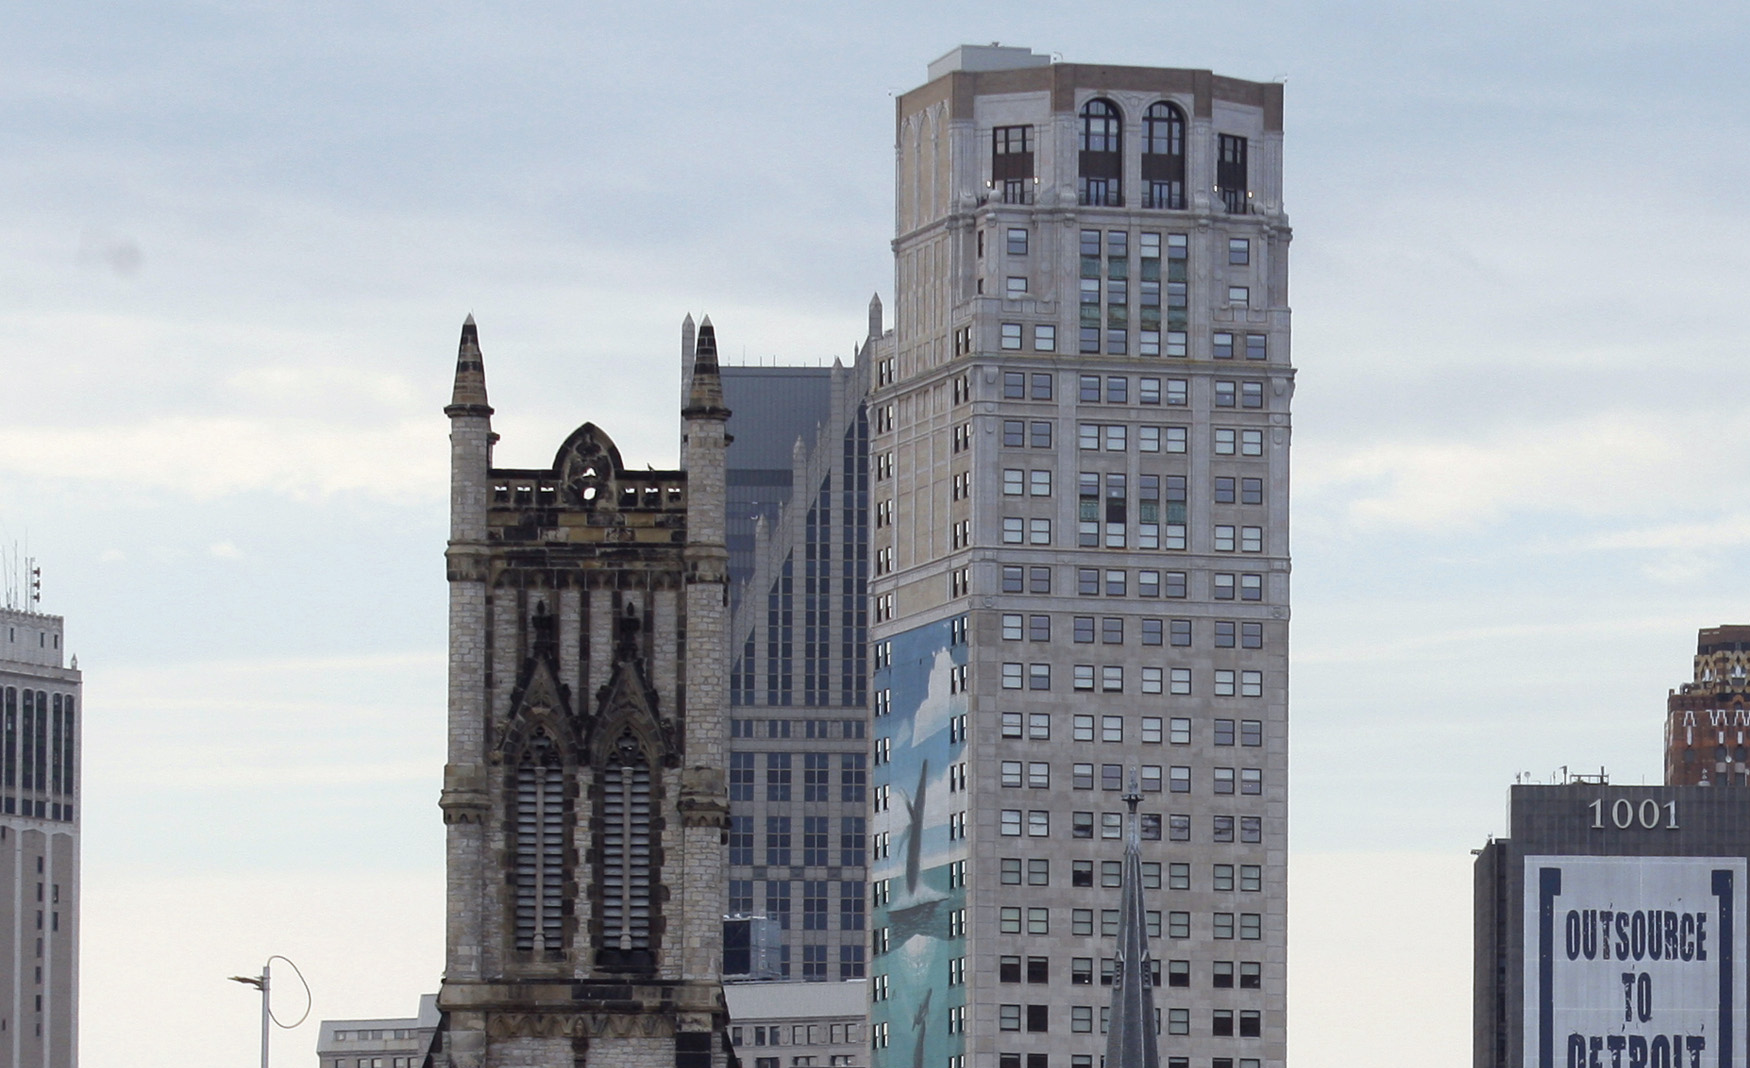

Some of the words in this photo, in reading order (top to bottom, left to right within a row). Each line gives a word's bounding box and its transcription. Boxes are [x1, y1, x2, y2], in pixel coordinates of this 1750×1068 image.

[1588, 798, 1680, 830] 1001
[1566, 910, 1707, 961] OUTSOURCE
[1622, 972, 1653, 1022] TO
